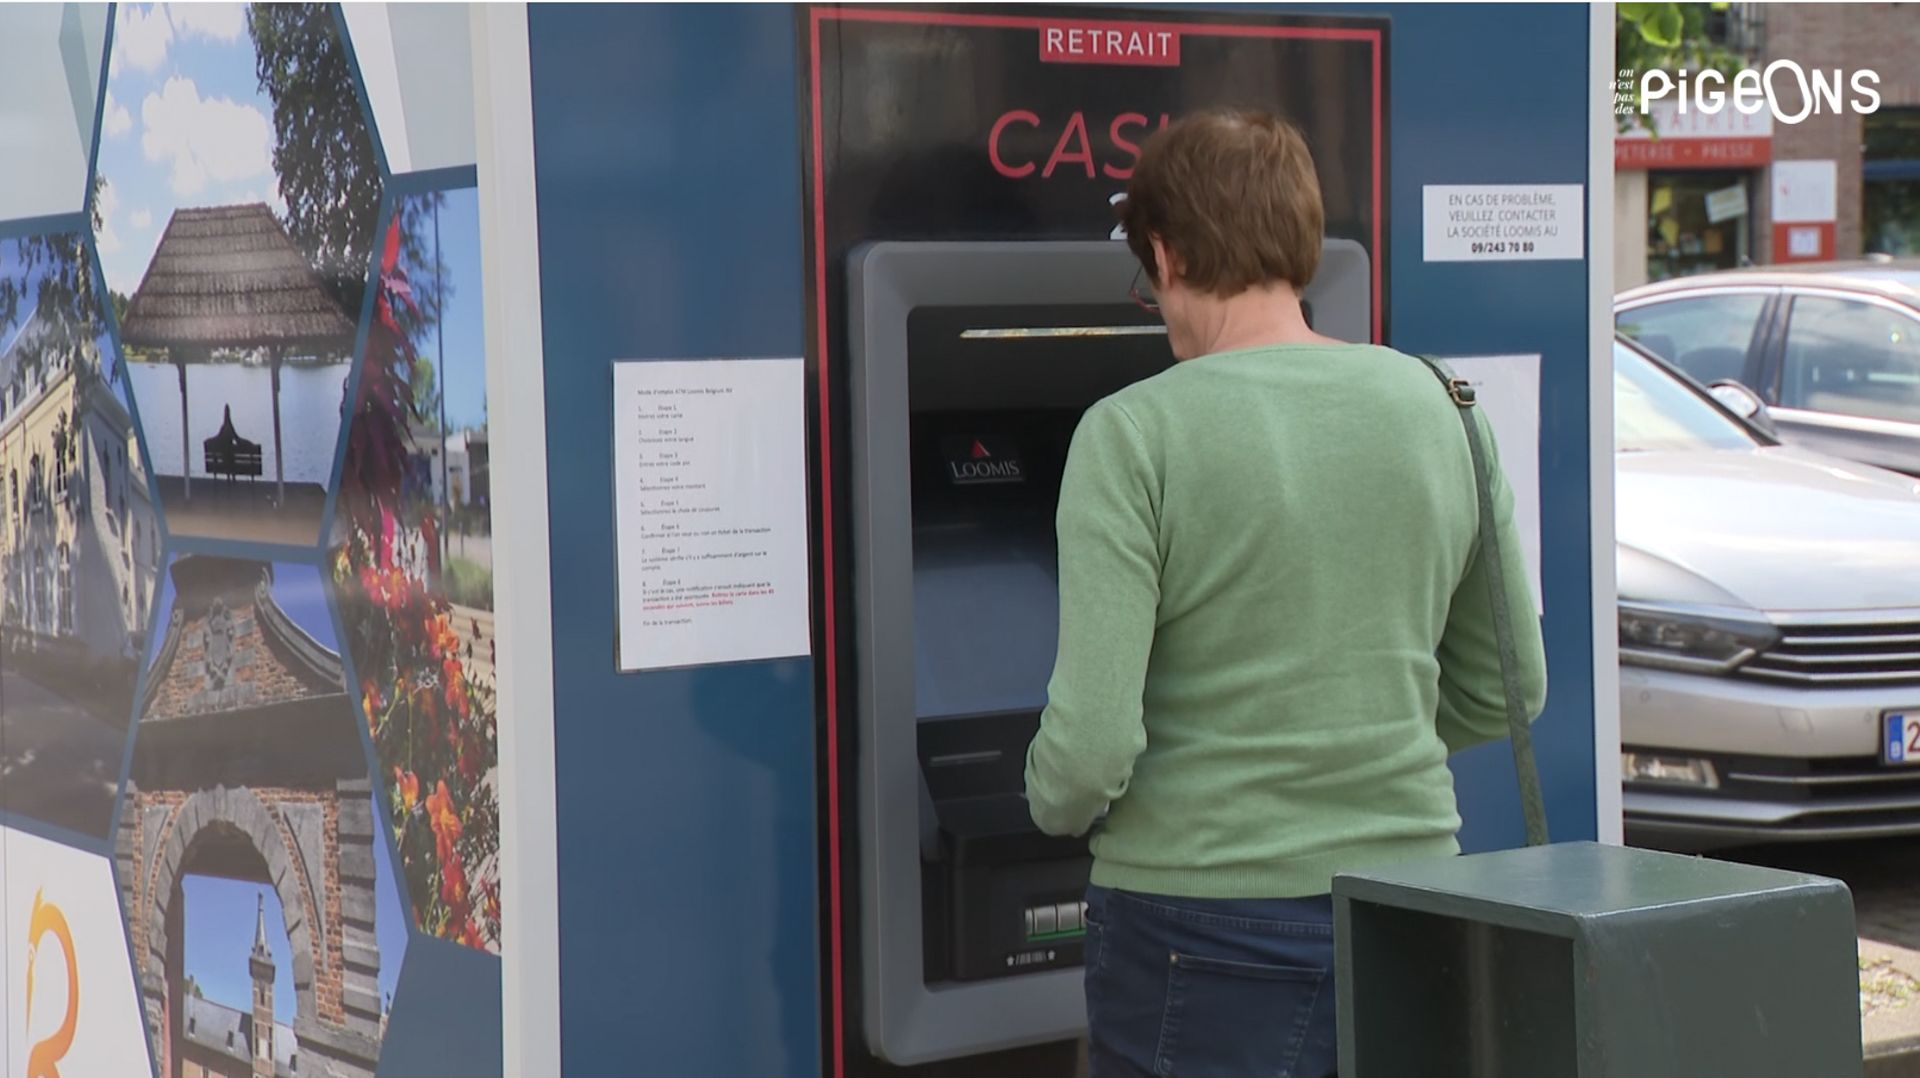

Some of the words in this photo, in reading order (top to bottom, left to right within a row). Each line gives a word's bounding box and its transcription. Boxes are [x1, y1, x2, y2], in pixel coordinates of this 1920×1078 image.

[1047, 28, 1172, 56] RETRAIT
[988, 110, 1170, 180] CAS
[1449, 194, 1462, 206] EN
[1465, 194, 1484, 206] CAS
[1486, 194, 1499, 205] DE
[1449, 210, 1494, 222] VEUILLEZ
[1498, 210, 1556, 222] CONTACTER
[1447, 227, 1459, 238] LA
[1462, 225, 1500, 238] SOCIÉTÉ
[1504, 226, 1542, 238] LOOMIS
[1544, 226, 1558, 237] AU
[1471, 242, 1505, 253] 09/243
[1509, 242, 1520, 252] 70
[1523, 242, 1534, 252] 80
[951, 460, 1020, 478] LOOMIS
